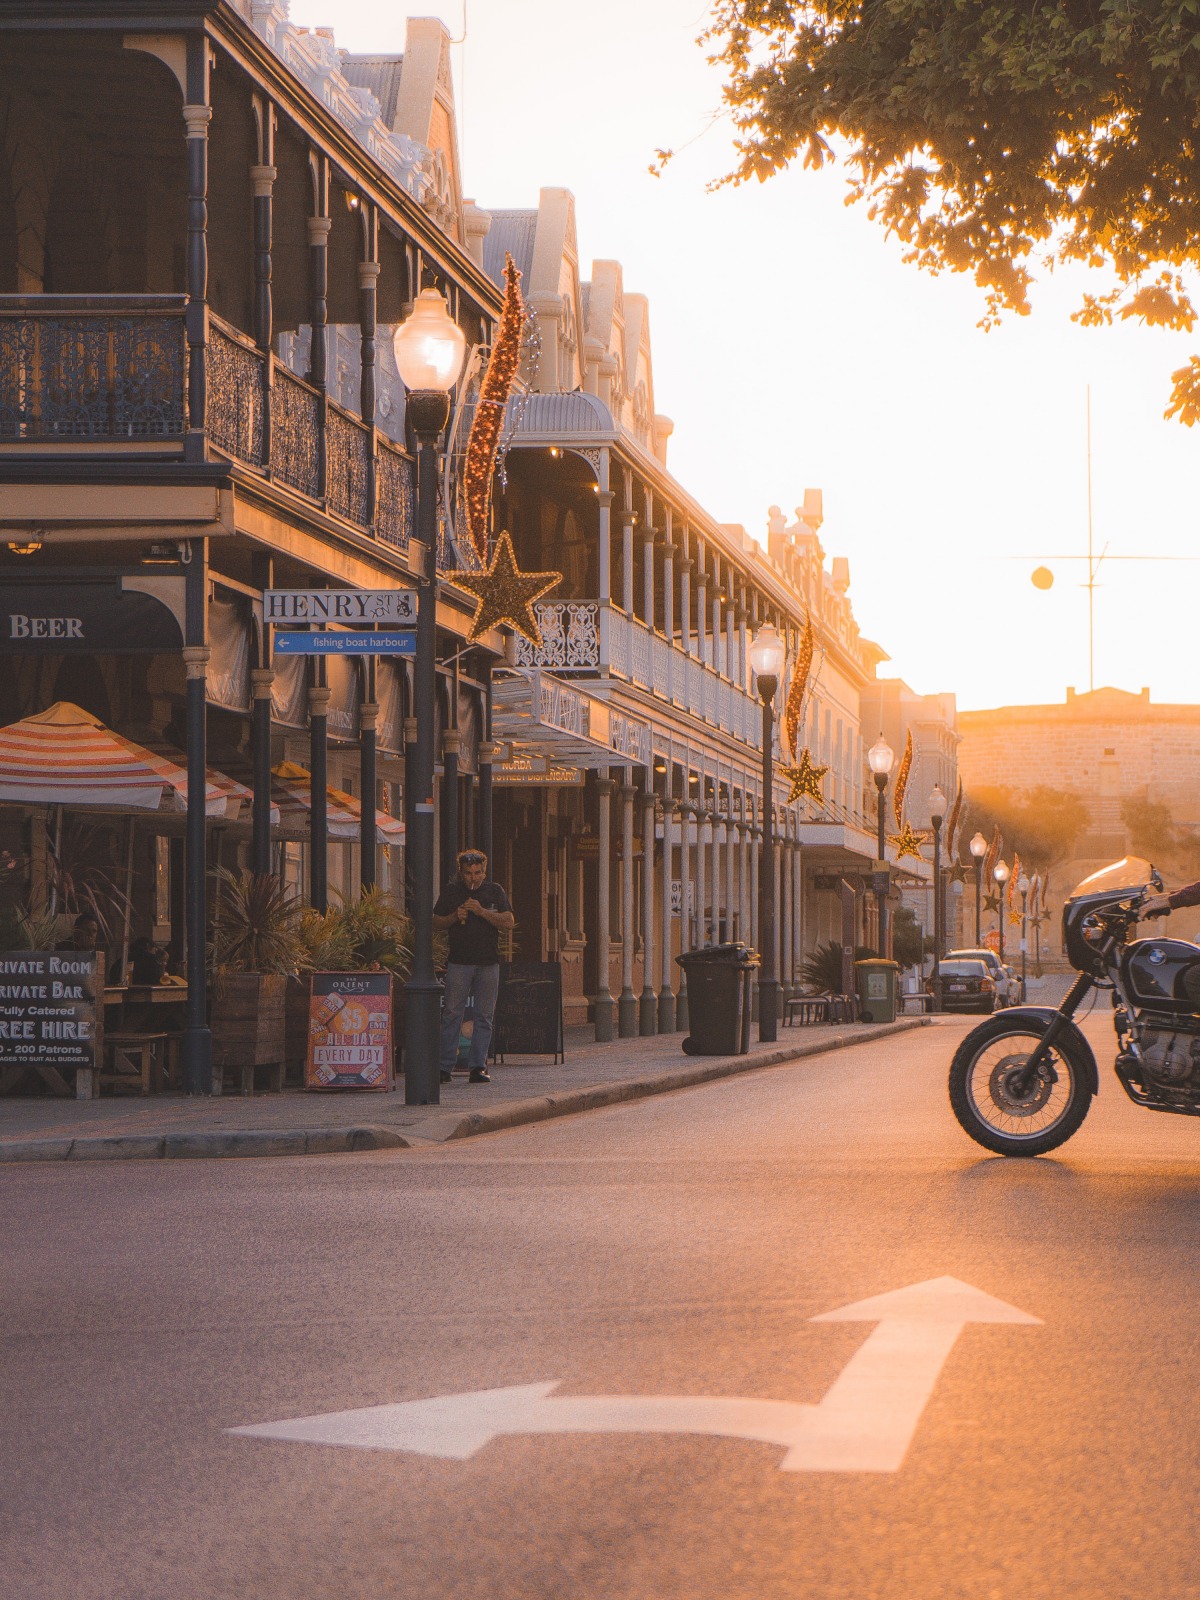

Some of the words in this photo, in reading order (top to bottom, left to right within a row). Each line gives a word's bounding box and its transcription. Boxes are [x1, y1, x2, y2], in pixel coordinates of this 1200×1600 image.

[268, 594, 372, 618] HENRY
[376, 594, 394, 606] ST
[8, 614, 85, 639] BEER
[313, 637, 343, 649] fishing
[345, 638, 367, 648] boat
[369, 637, 408, 648] harbour
[50, 957, 92, 974] ROOM
[52, 981, 84, 999] BAR
[332, 981, 370, 989] ORIENT
[0, 1006, 25, 1017] Fully
[28, 1006, 76, 1015] Catered
[323, 999, 339, 1012] EMU
[341, 1008, 363, 1032] $5
[369, 1021, 387, 1029] EMU
[41, 1021, 91, 1040] HIRE
[327, 1033, 347, 1046] ALL
[353, 1033, 375, 1046] DAY
[15, 1045, 36, 1054] 200
[39, 1045, 83, 1054] Patrons
[318, 1049, 353, 1062] EVERY
[359, 1049, 381, 1062] DAY
[315, 1068, 330, 1084] EMU
[367, 1067, 383, 1083] EMU
